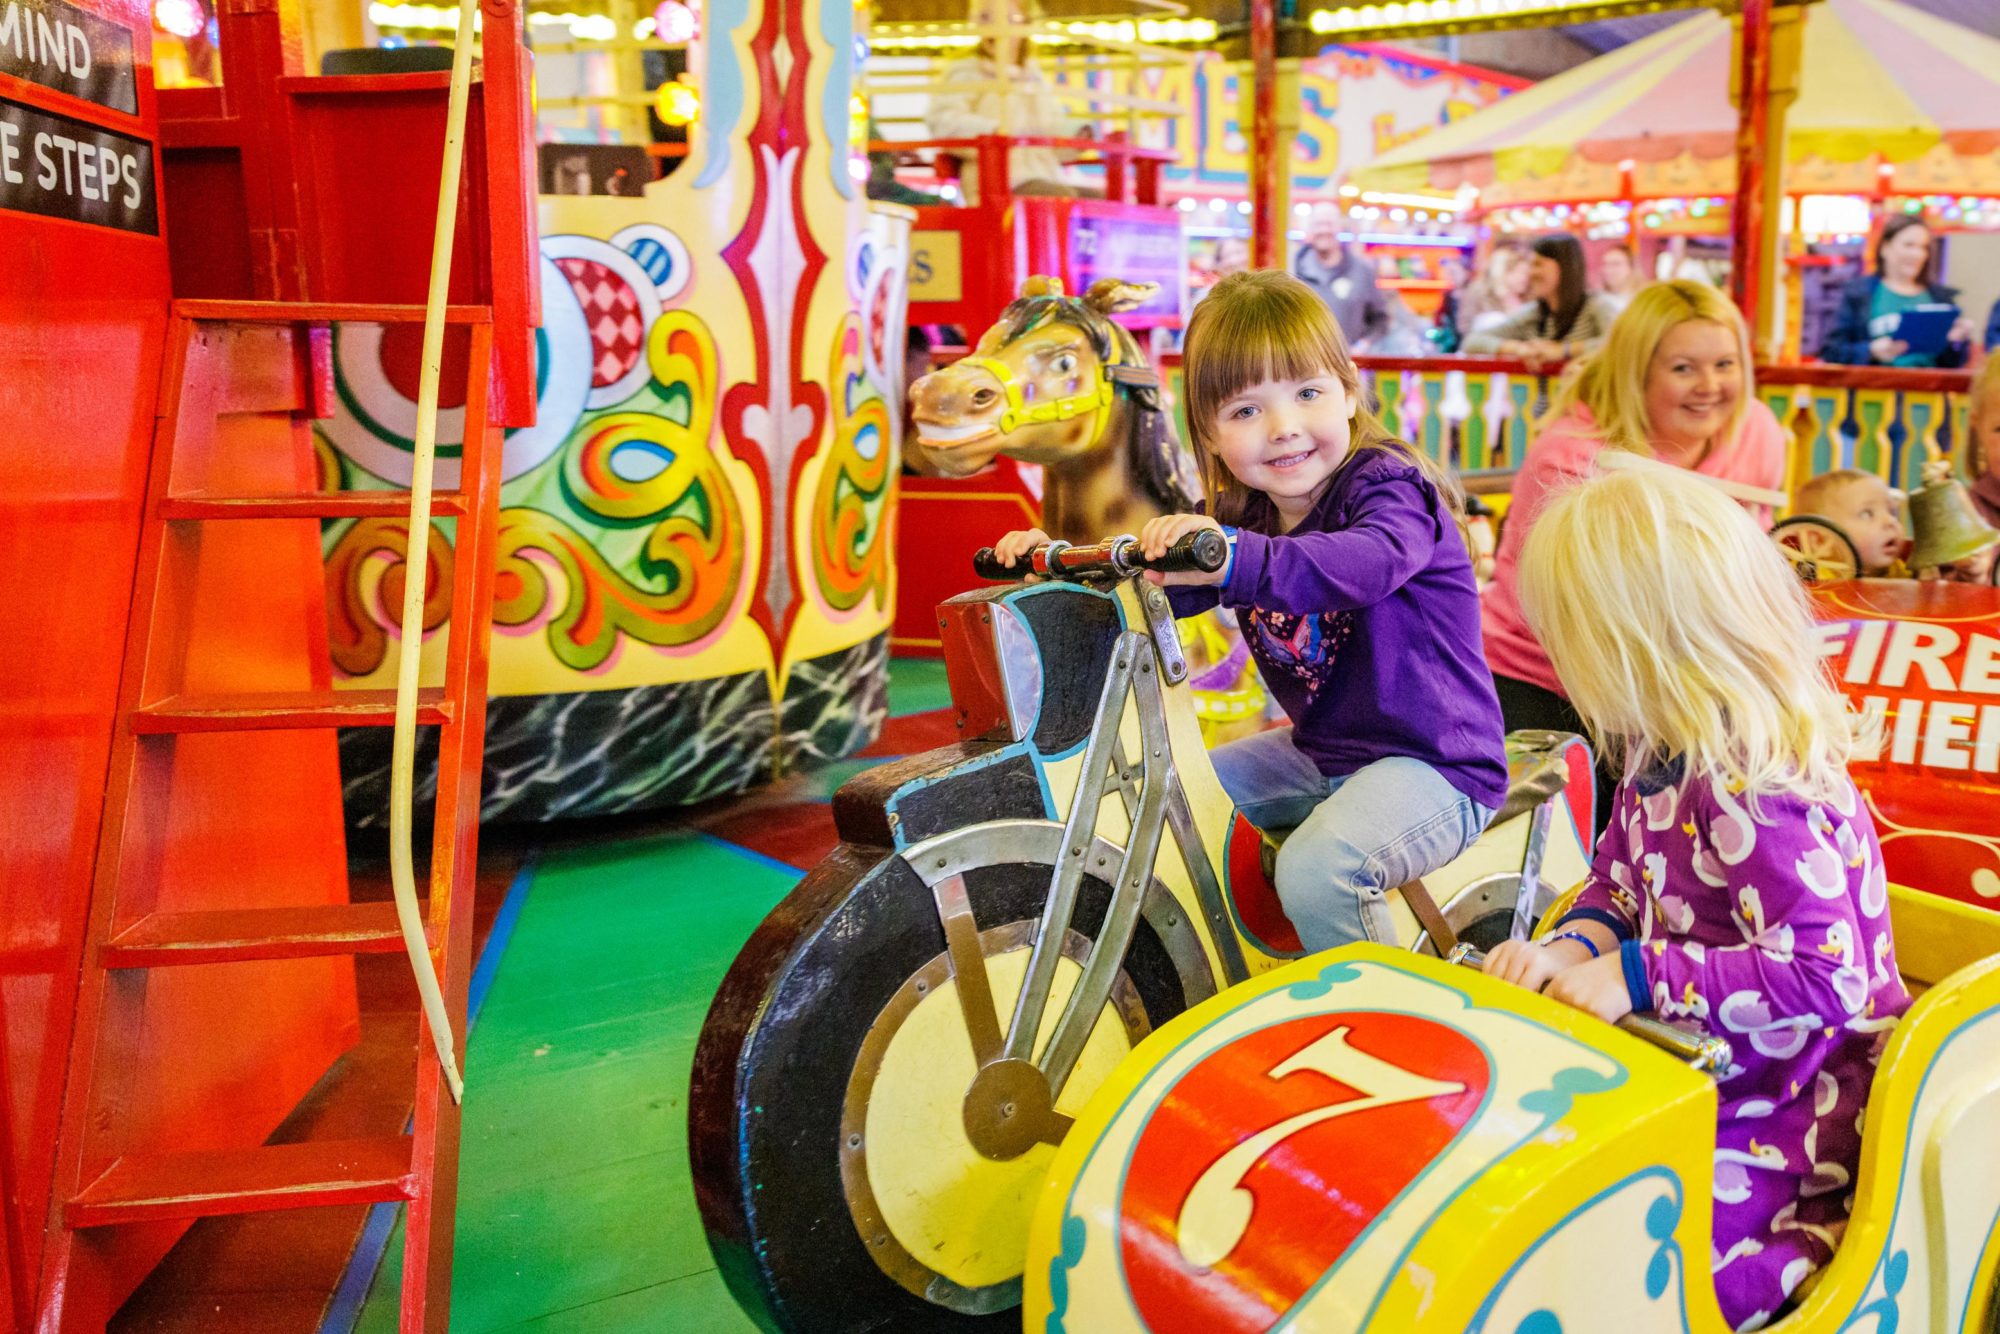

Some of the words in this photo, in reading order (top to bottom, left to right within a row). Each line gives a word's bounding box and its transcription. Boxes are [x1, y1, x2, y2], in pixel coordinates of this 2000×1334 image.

[0, 2, 91, 80] MIND
[34, 132, 141, 209] STEPS
[1806, 620, 2000, 695] FIRE
[1176, 1024, 1468, 1268] 7
